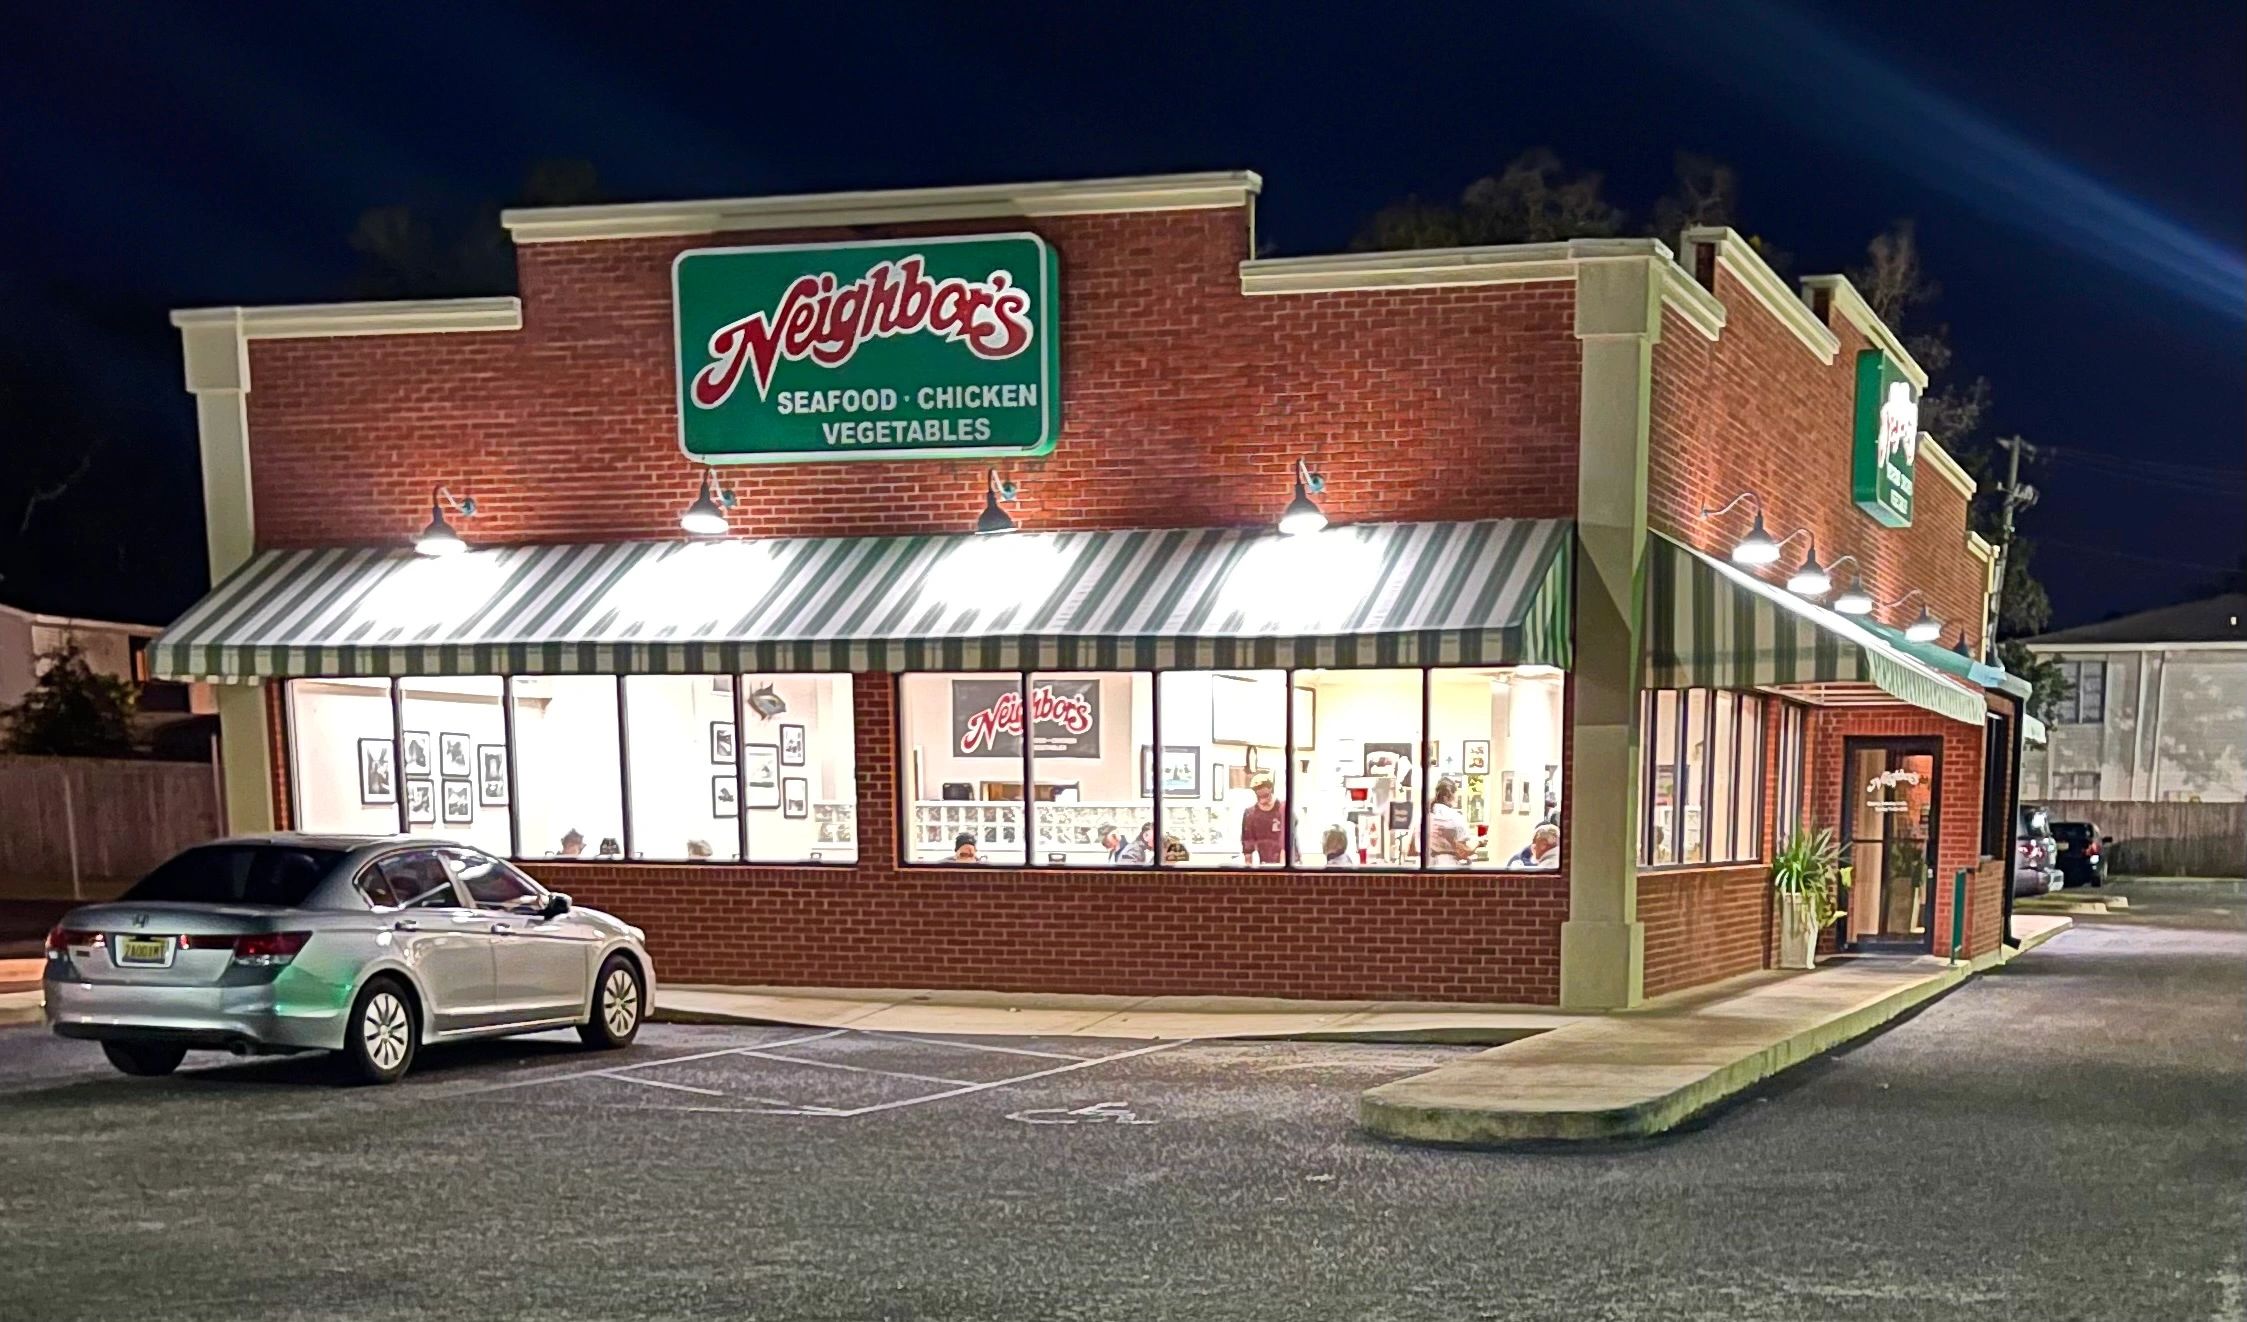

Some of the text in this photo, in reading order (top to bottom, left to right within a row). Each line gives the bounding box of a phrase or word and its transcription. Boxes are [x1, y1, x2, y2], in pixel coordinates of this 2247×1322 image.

[692, 254, 1033, 408] Neighbor's
[777, 384, 1037, 415] SEAFOOD CHICKEN
[822, 418, 991, 445] VEGETABLES
